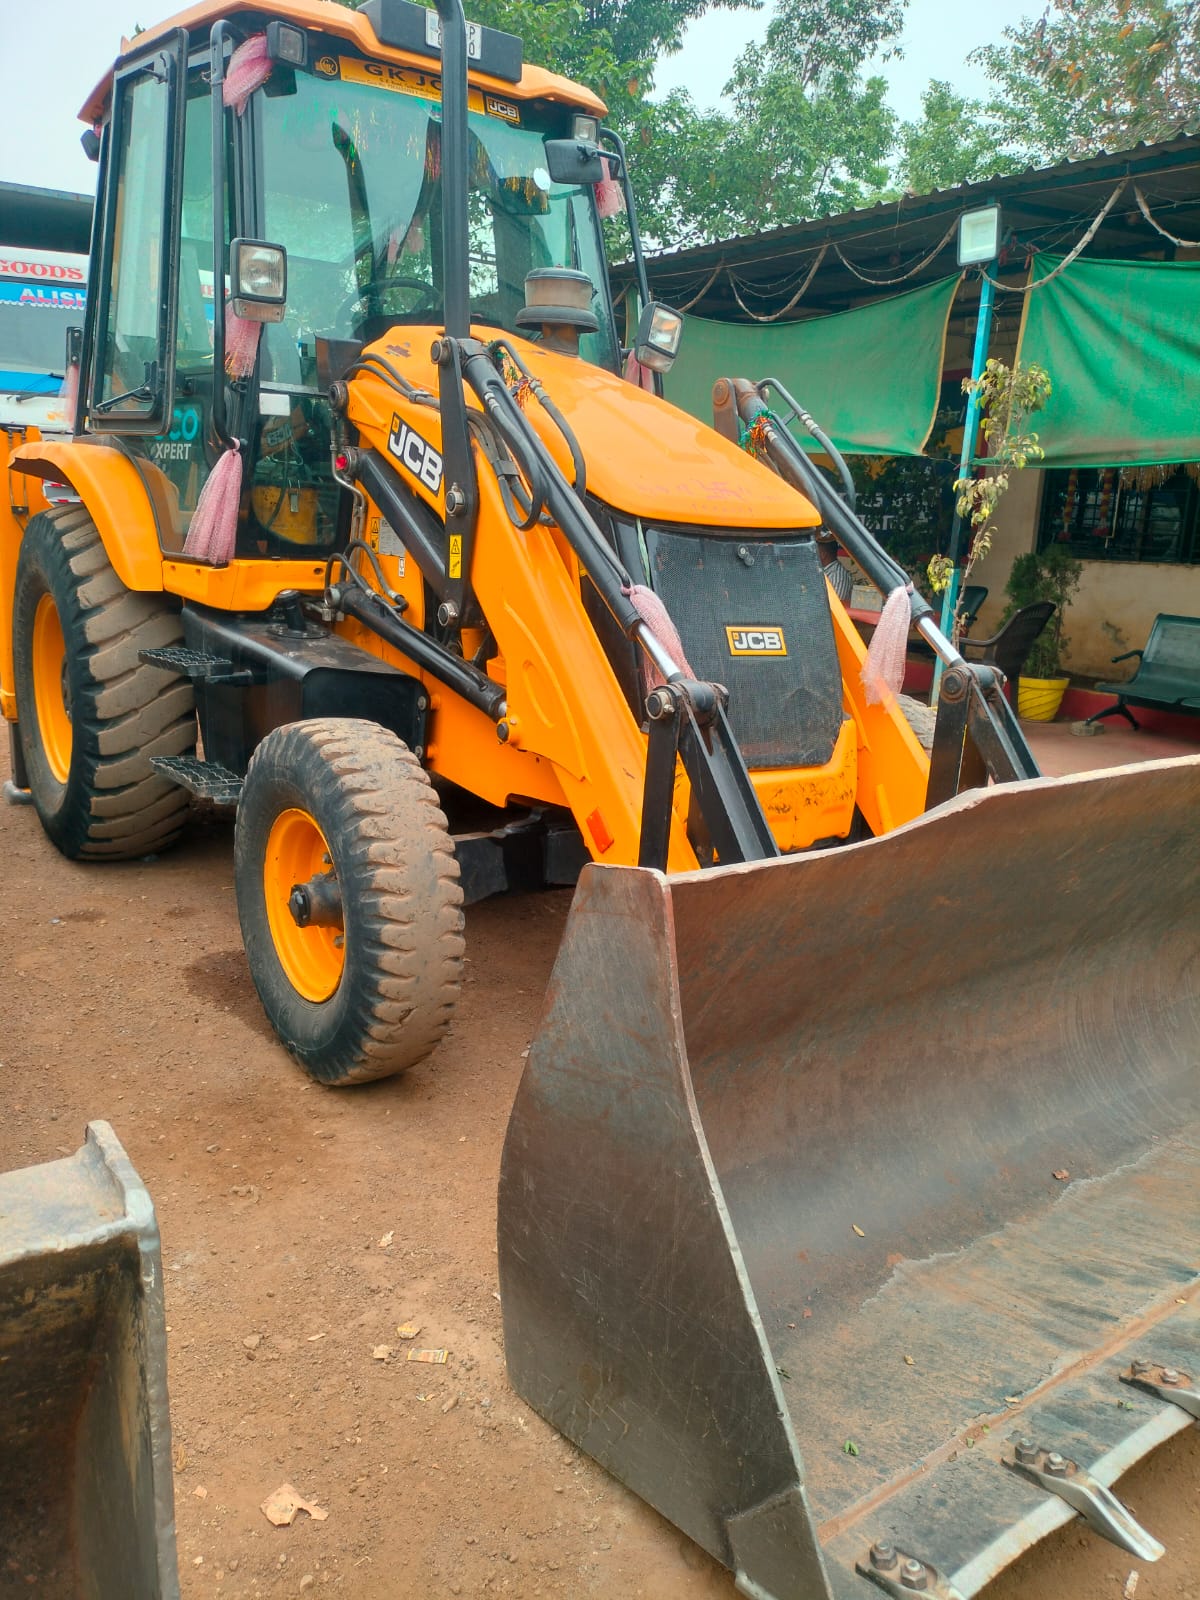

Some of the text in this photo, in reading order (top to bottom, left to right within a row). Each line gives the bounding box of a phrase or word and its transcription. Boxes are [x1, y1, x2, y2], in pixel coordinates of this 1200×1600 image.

[363, 63, 406, 82] GK
[489, 99, 517, 118] JCB
[154, 408, 199, 441] CO
[389, 424, 443, 493] JCB
[733, 632, 782, 650] JCB
